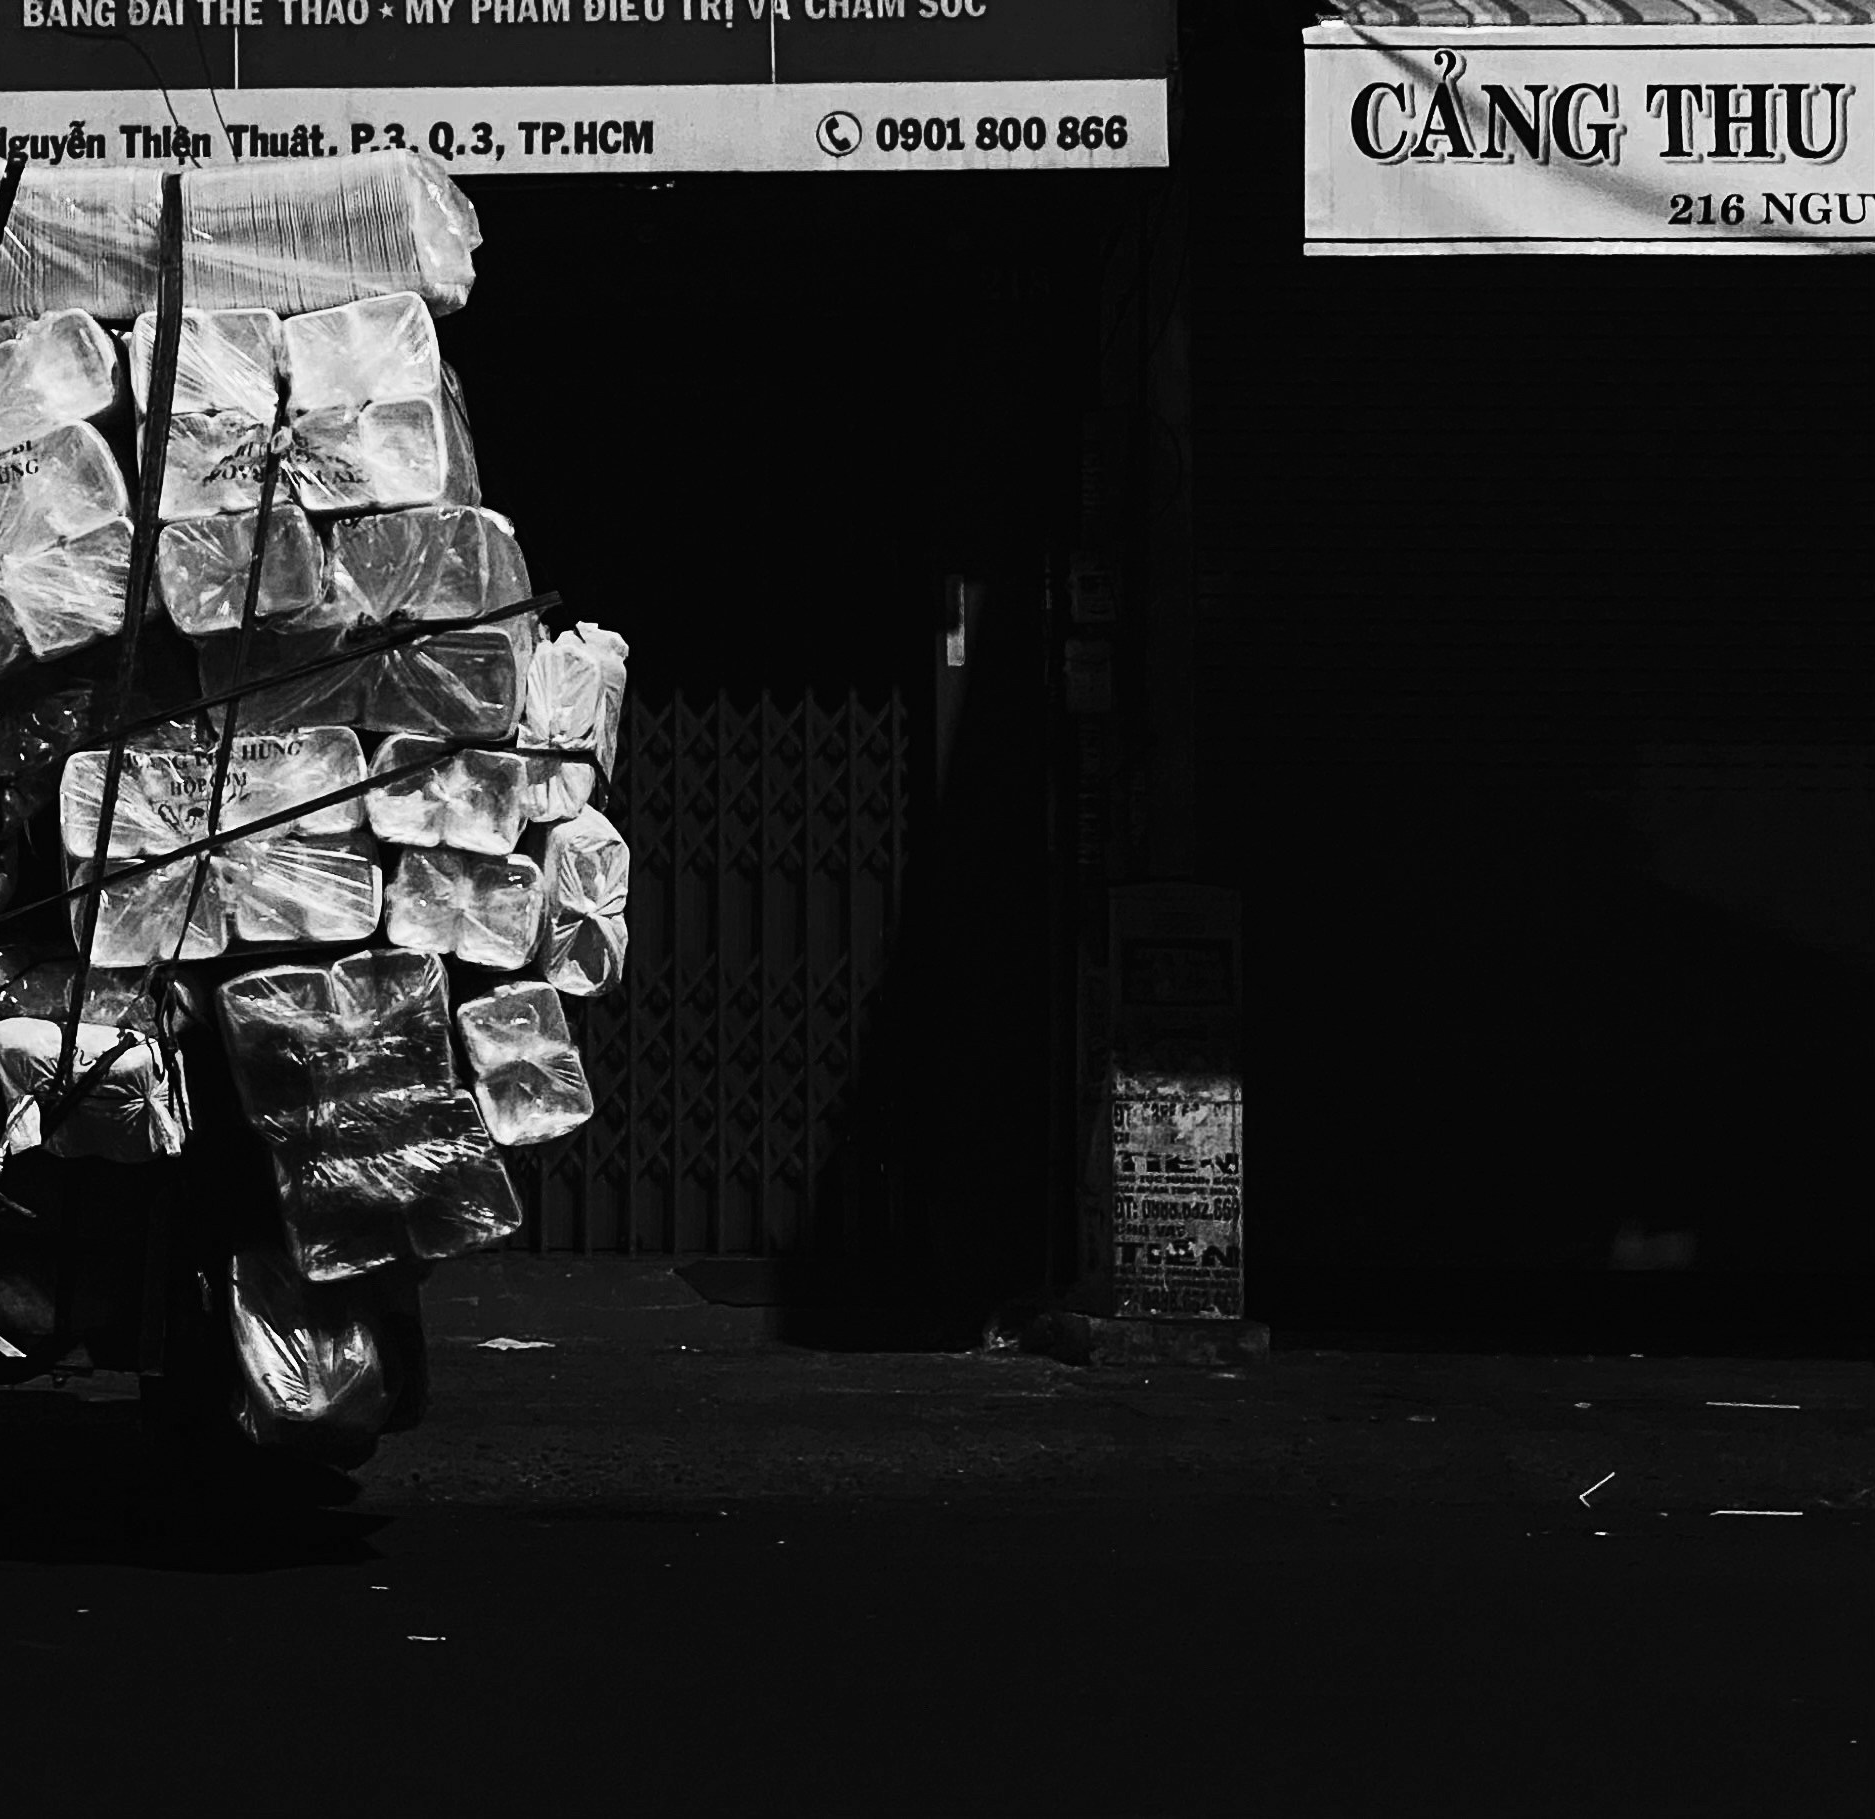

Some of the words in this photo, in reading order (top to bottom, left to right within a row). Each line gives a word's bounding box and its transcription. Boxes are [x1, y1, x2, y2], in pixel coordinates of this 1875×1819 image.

[1350, 50, 1626, 166] CẢNG
[1645, 82, 1856, 165] THU
[428, 121, 505, 162] Q.3,
[517, 119, 655, 156] TP.HCM
[875, 116, 966, 153] 0901
[975, 116, 1047, 153] 800
[1056, 114, 1129, 152] 866
[1667, 192, 1745, 226] 216
[1760, 192, 1875, 226] NGU
